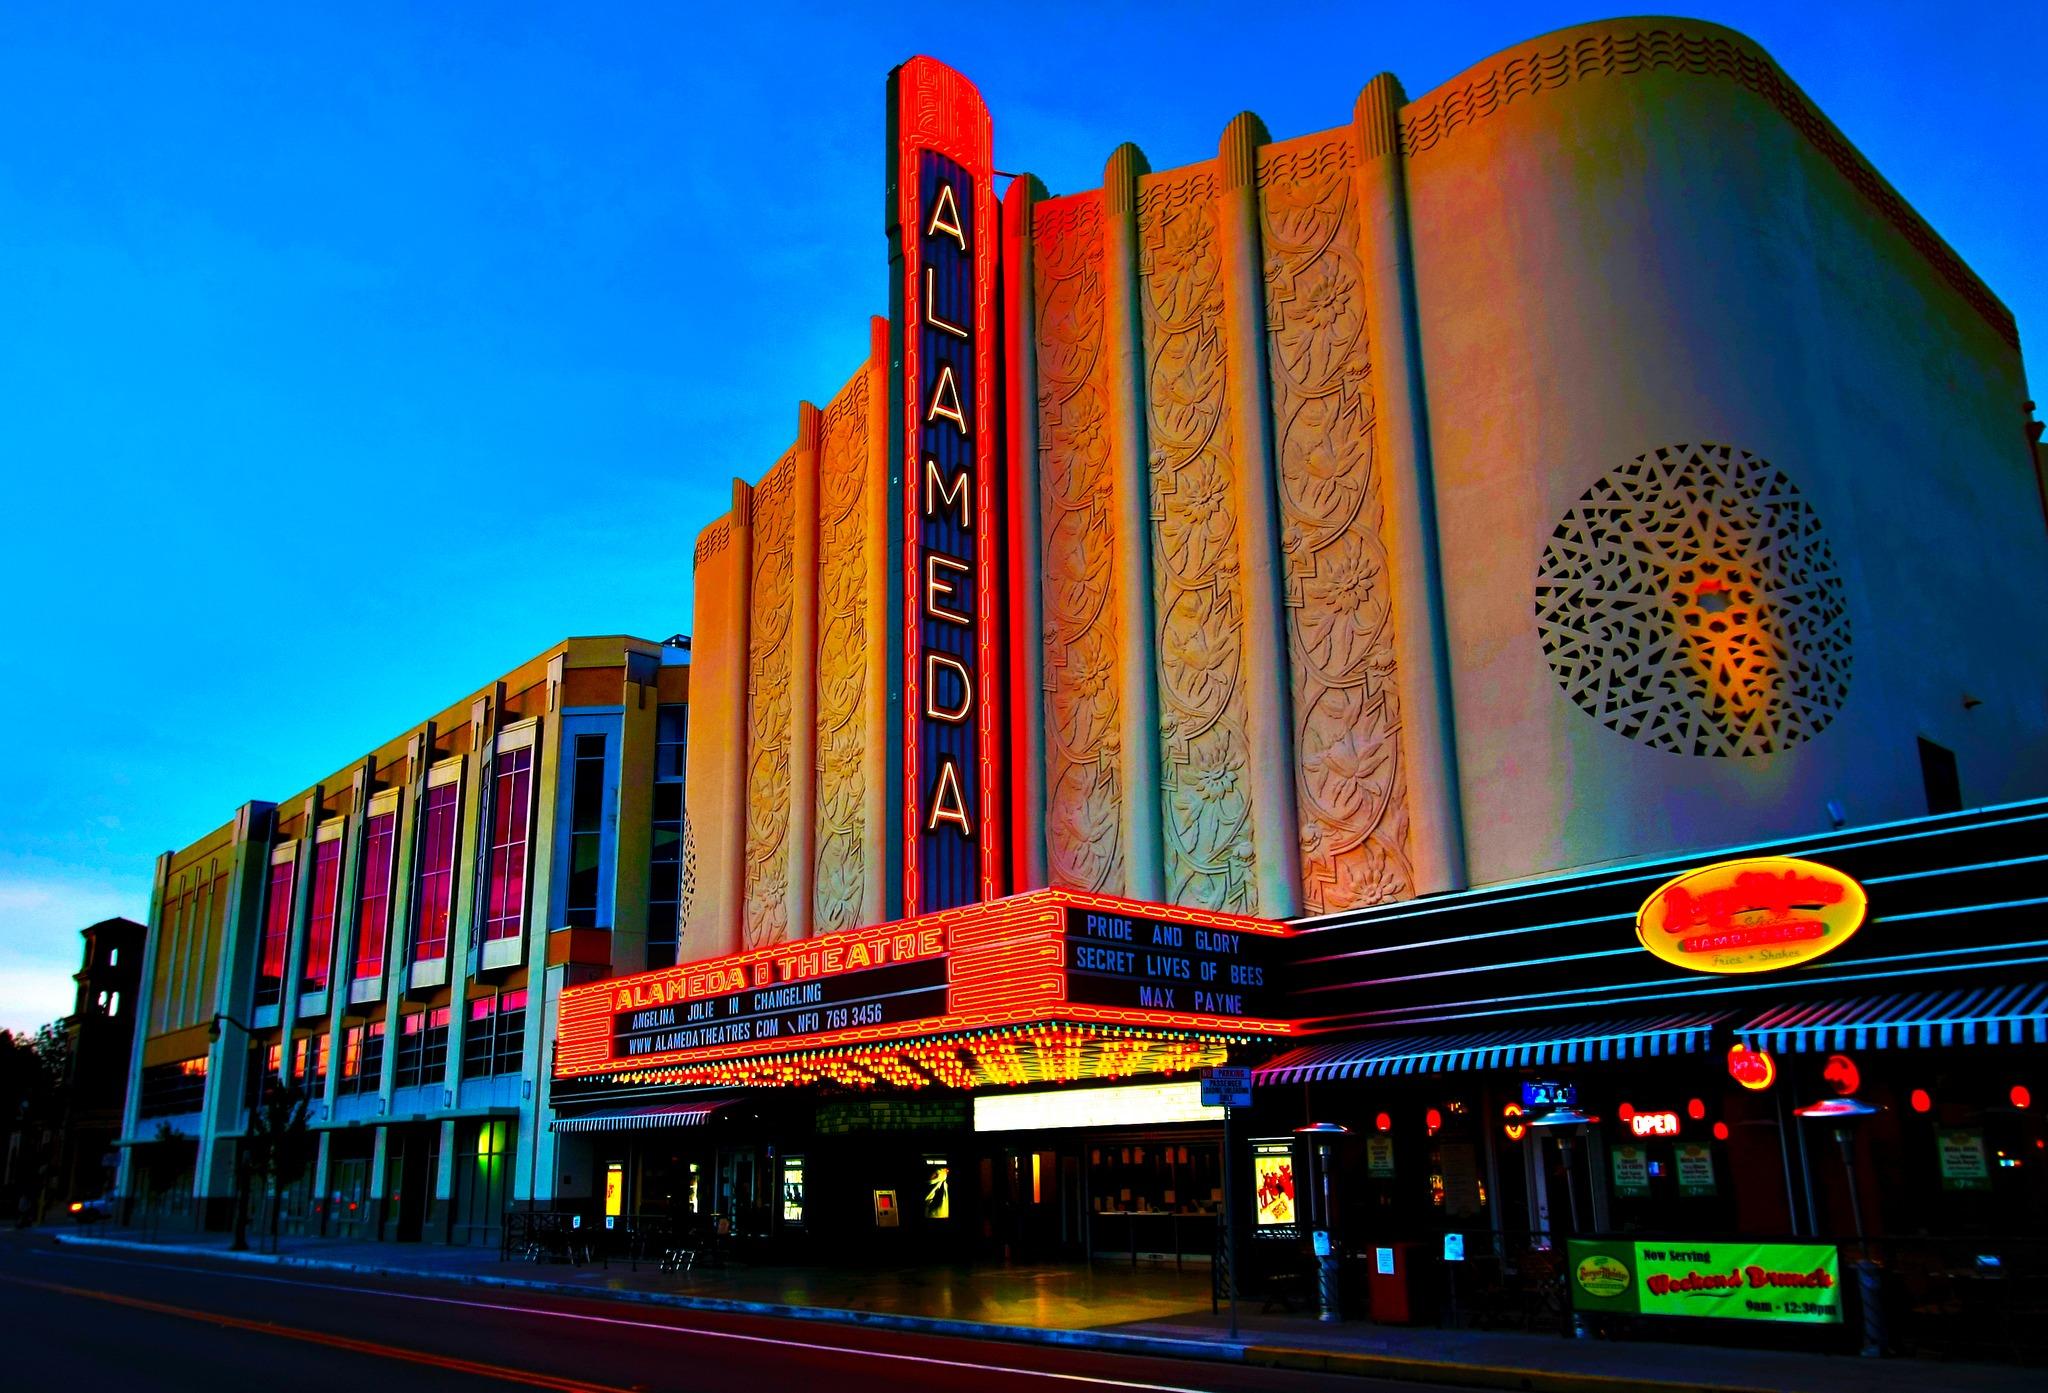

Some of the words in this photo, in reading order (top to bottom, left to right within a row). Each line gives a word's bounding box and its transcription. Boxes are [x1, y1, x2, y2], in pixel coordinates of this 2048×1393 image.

[926, 184, 973, 838] ALAMEDA
[1087, 914, 1133, 941] PRIDE
[1152, 925, 1183, 947] AND
[1195, 930, 1239, 954] GLORY
[615, 967, 745, 1010] ALAMEDA
[777, 928, 945, 981] THEATRE
[1076, 946, 1135, 973] SECRET
[1147, 954, 1191, 979] LIVES
[1200, 961, 1217, 981] OF
[1231, 964, 1264, 986] BEES
[1712, 953, 1744, 967] Fries
[1760, 949, 1801, 962] Shakes
[632, 1011, 675, 1030] ANGELINA
[687, 1000, 714, 1021] JOLIE
[729, 996, 739, 1015] IN
[754, 983, 822, 1010] CHANGELING
[1140, 985, 1175, 1009] MAX
[1194, 990, 1243, 1015] PAYNE
[629, 1036, 652, 1055] WWW
[756, 1020, 779, 1038] COM
[826, 1009, 848, 1030] 769
[851, 1003, 882, 1025] 3456
[1632, 1114, 1677, 1135] OPEN
[1643, 1250, 1666, 1261] Now
[1669, 1250, 1711, 1264] Serving
[1647, 1268, 1743, 1296] Weekend
[1745, 1265, 1834, 1289] Brunch
[1745, 1300, 1773, 1314] 9am
[1784, 1302, 1837, 1316] 12:30pm
